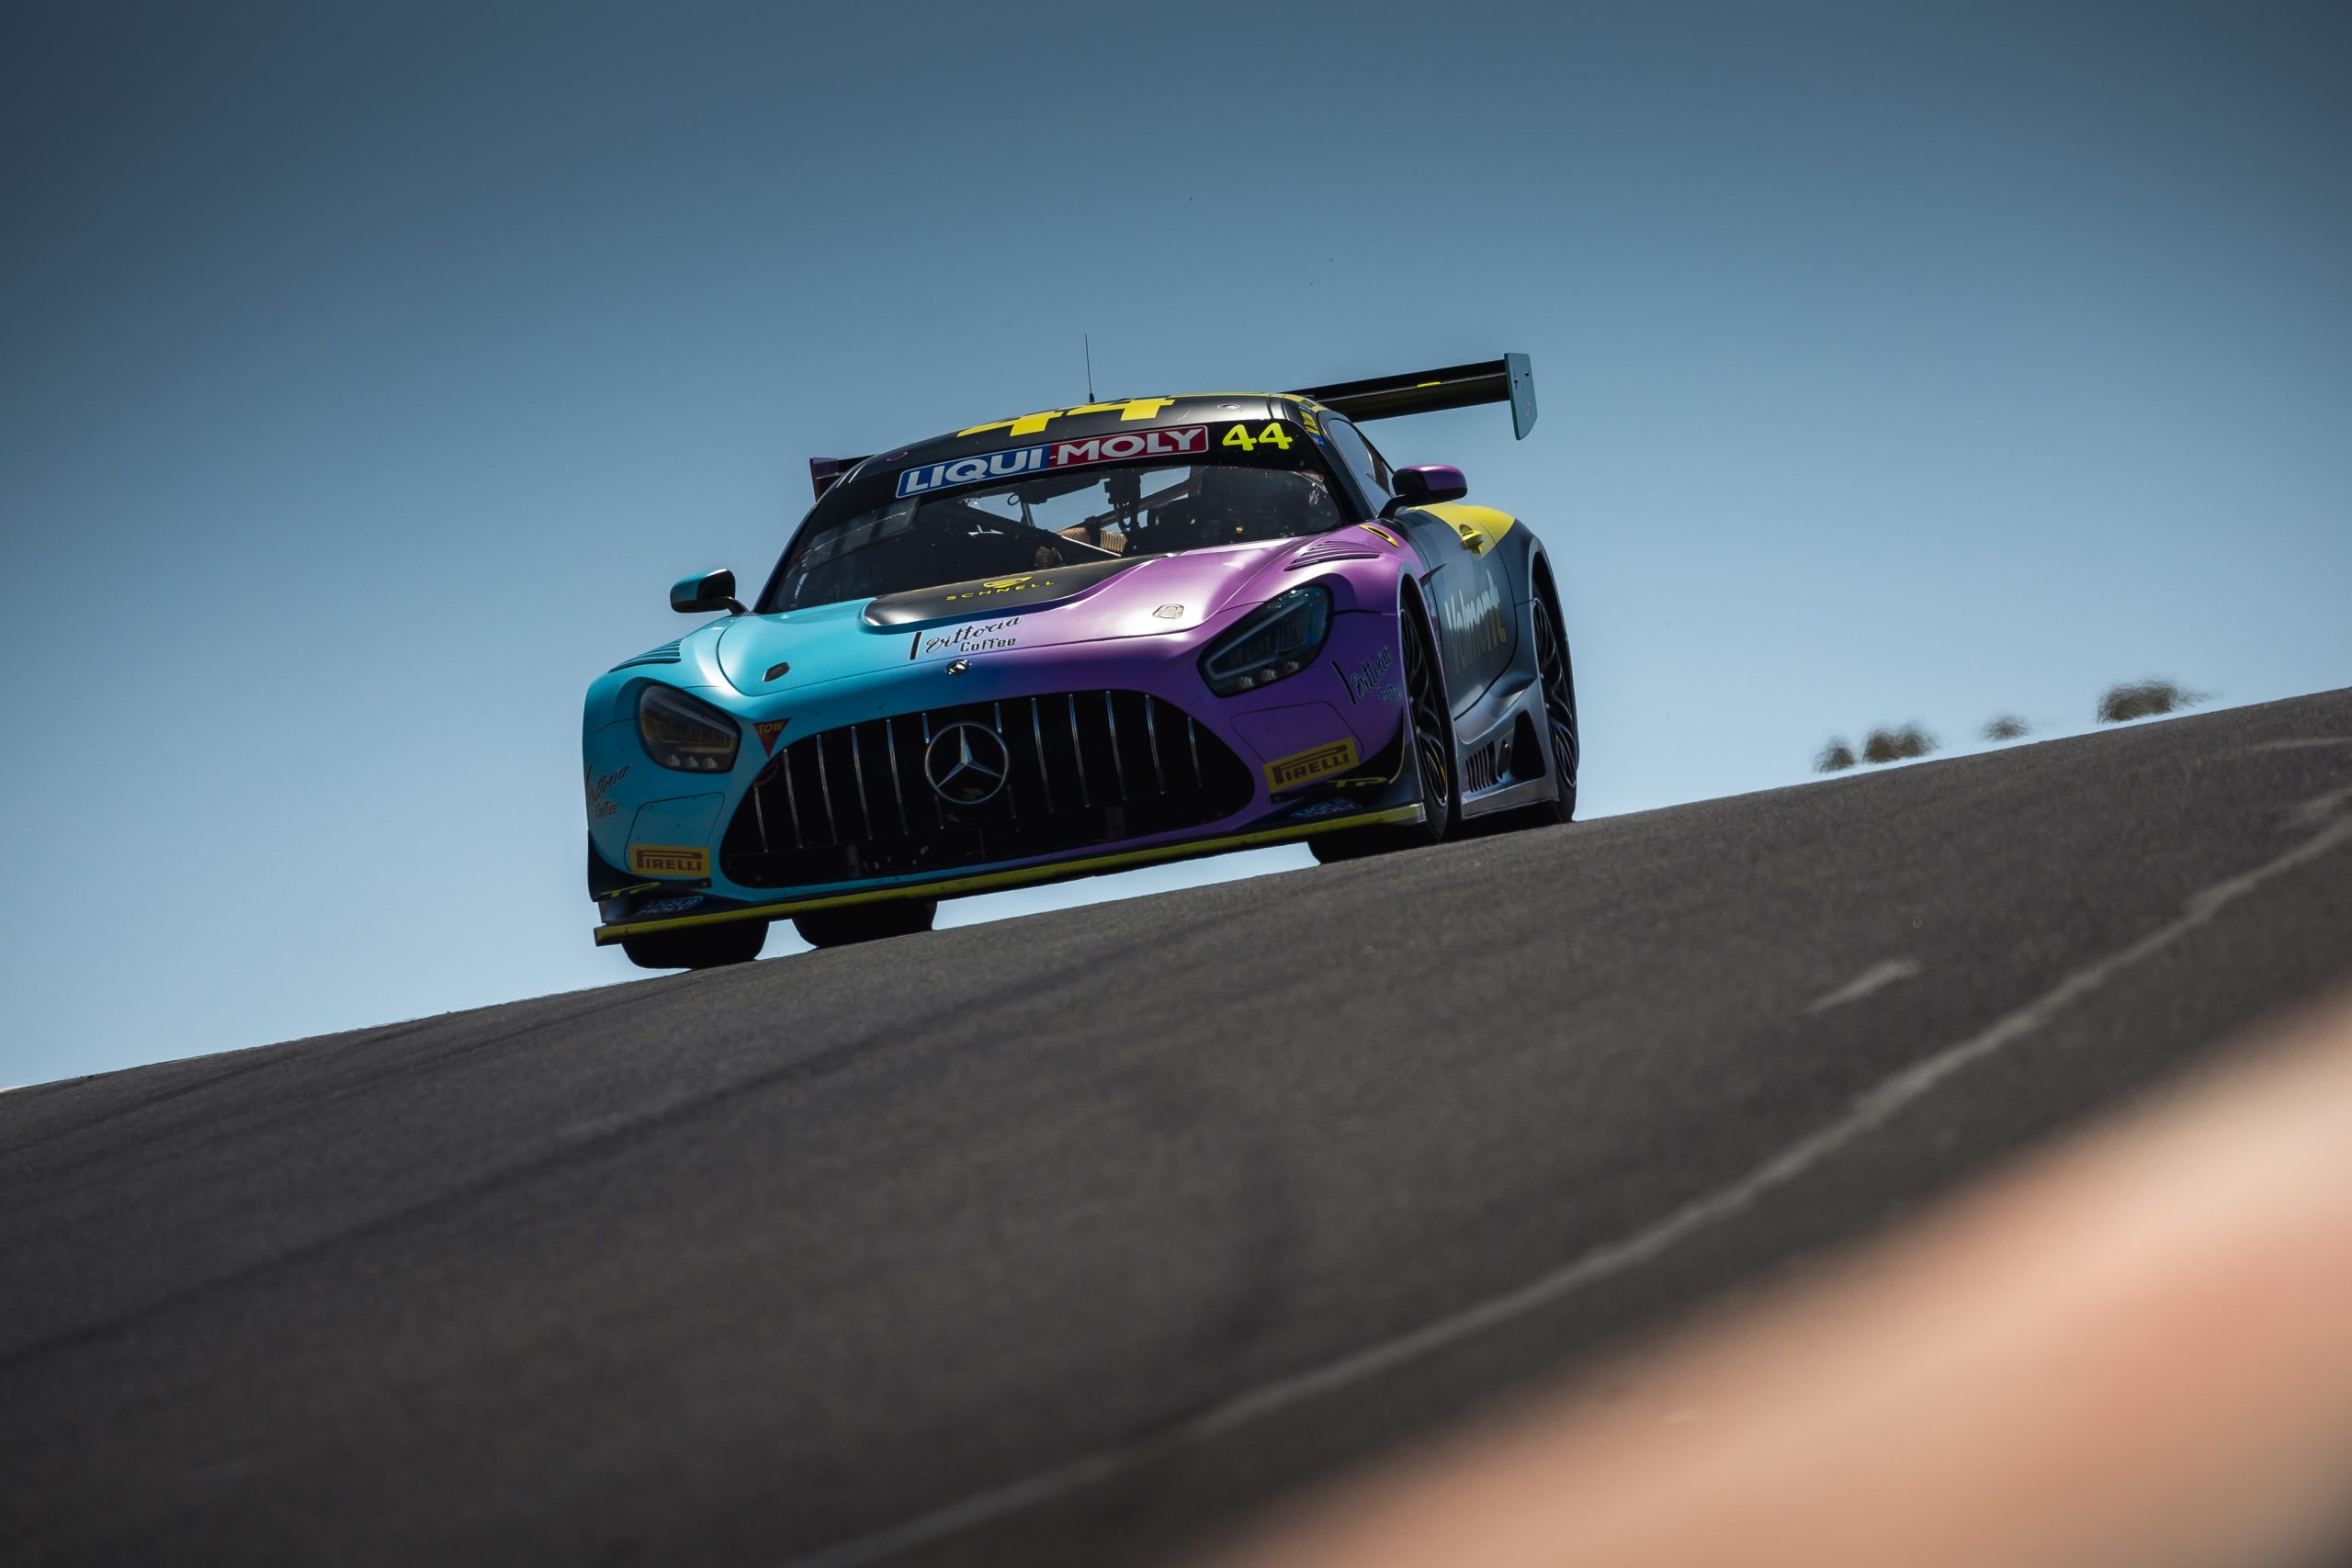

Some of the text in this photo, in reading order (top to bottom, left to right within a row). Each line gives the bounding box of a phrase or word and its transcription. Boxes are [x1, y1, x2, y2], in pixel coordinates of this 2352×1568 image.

[1222, 422, 1294, 451] 44
[906, 427, 1204, 493] LIQUI MOLY
[946, 581, 1056, 601] SCHNELL
[926, 617, 1022, 654] Vittoria
[960, 637, 1016, 652] Coffee
[757, 721, 786, 734] TOW
[1272, 744, 1351, 784] PIRELLI
[636, 850, 703, 872] PIRELLI
